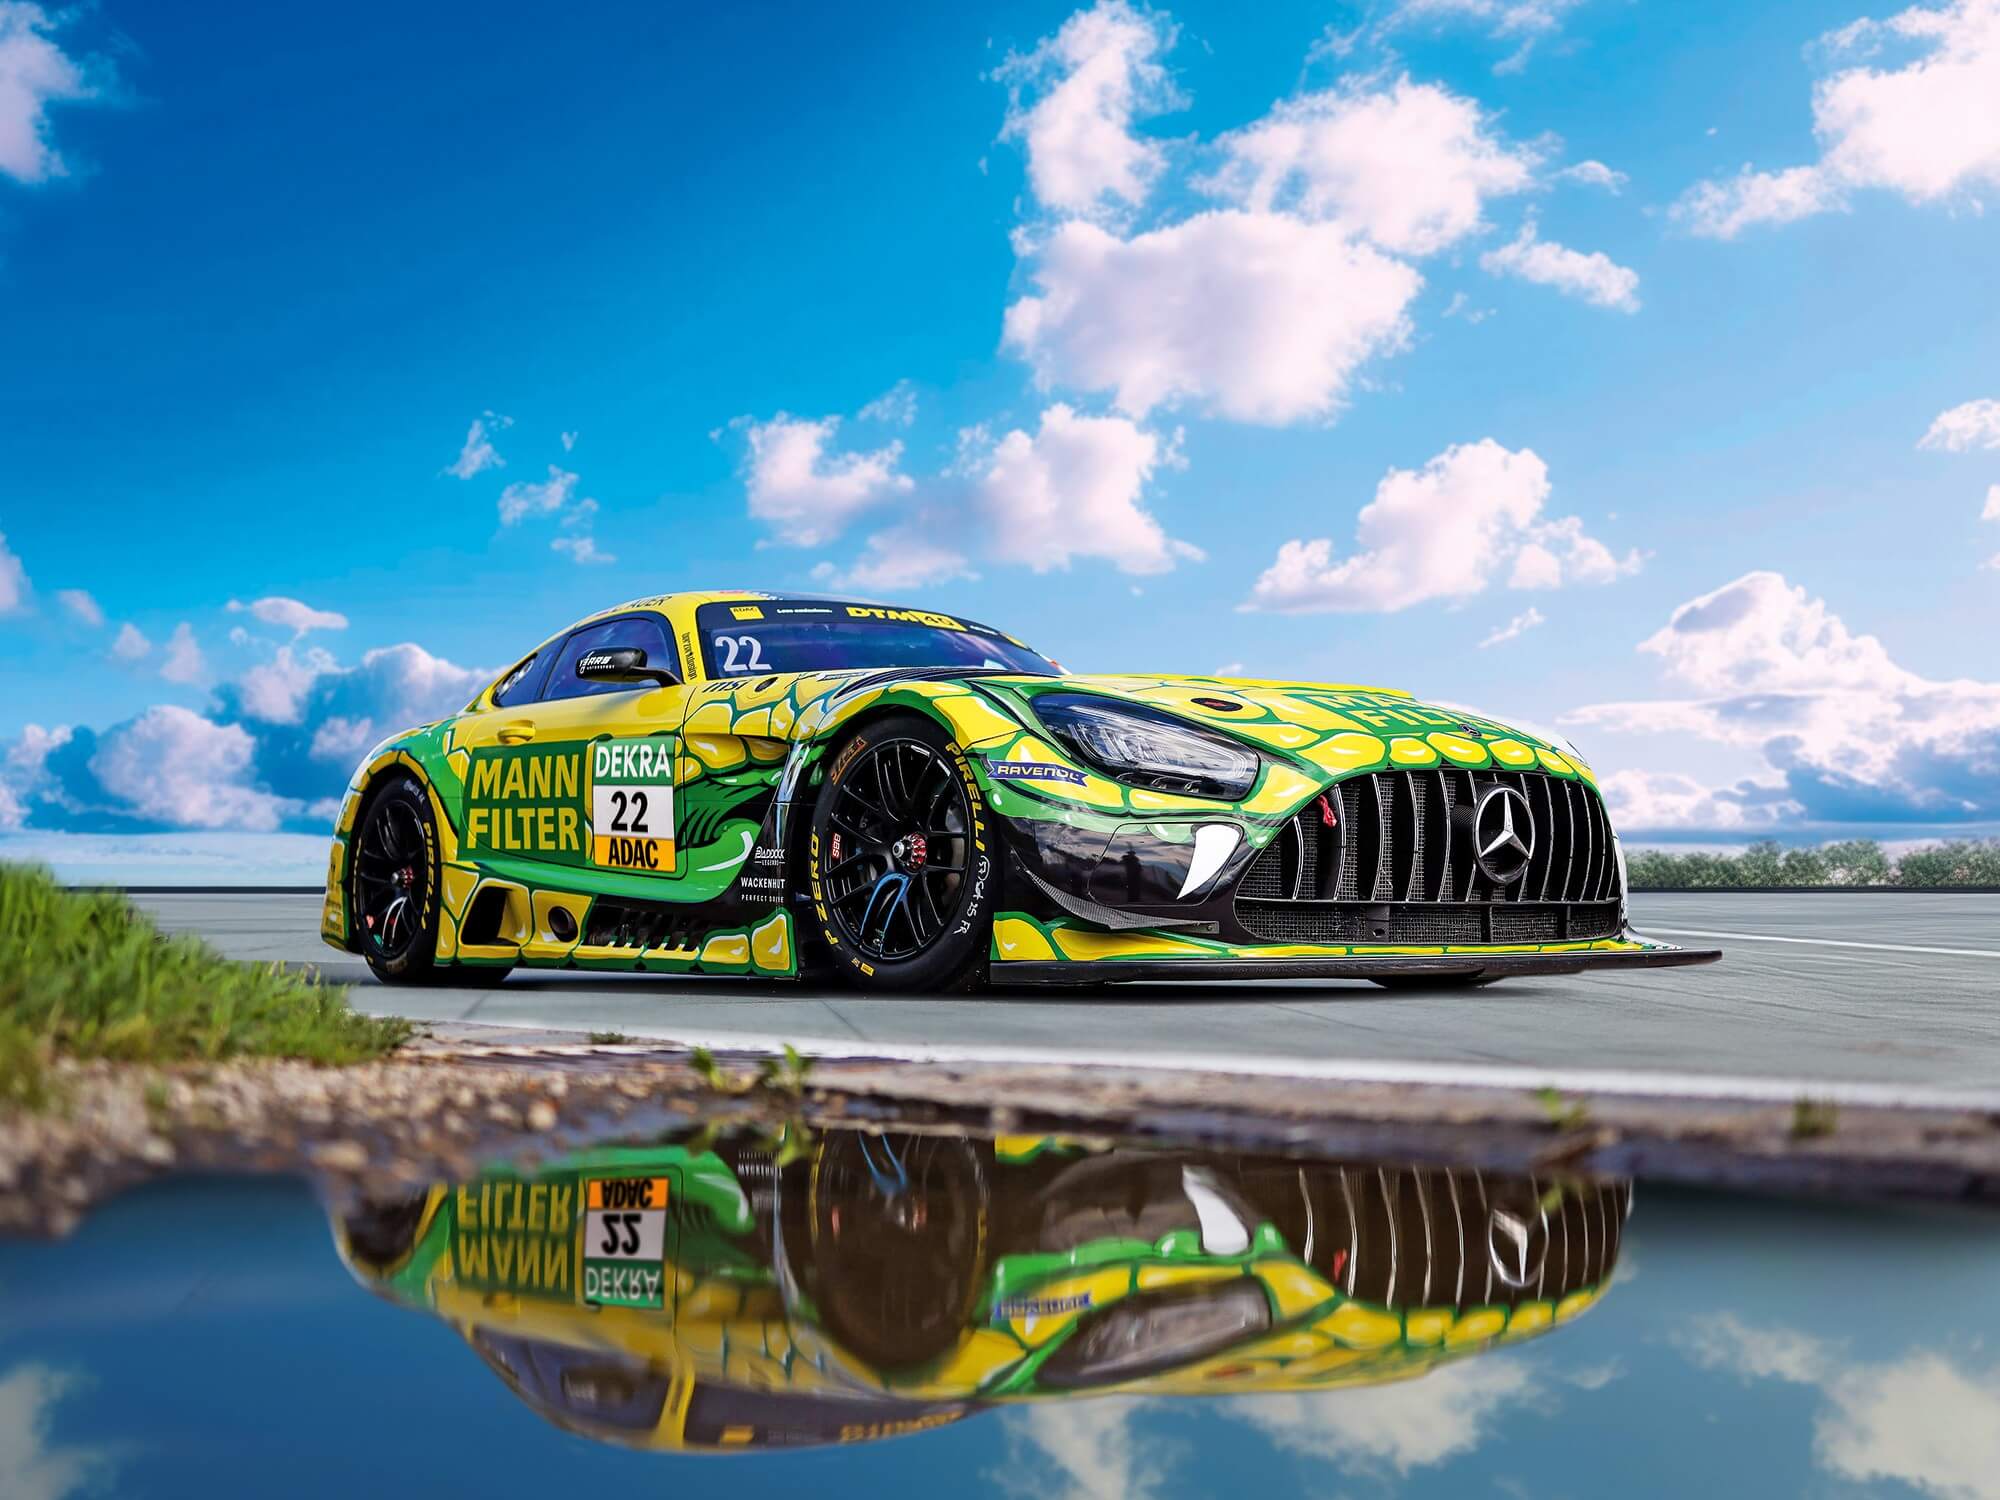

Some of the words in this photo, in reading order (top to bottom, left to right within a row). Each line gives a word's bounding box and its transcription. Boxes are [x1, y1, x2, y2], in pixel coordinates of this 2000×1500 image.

[846, 607, 918, 622] DTM
[714, 635, 773, 672] 22
[471, 754, 579, 800] MANN
[595, 744, 671, 778] DEKRA
[997, 765, 1080, 781] RAVENOL
[611, 790, 649, 833] 22
[945, 741, 985, 852] PIRELLI
[466, 807, 580, 850] FILTER
[831, 832, 841, 858] BBS
[608, 838, 659, 868] ADAC
[740, 877, 786, 889] WACKENHUT
[809, 833, 829, 923] ZERO
[741, 894, 768, 902] PERFECT
